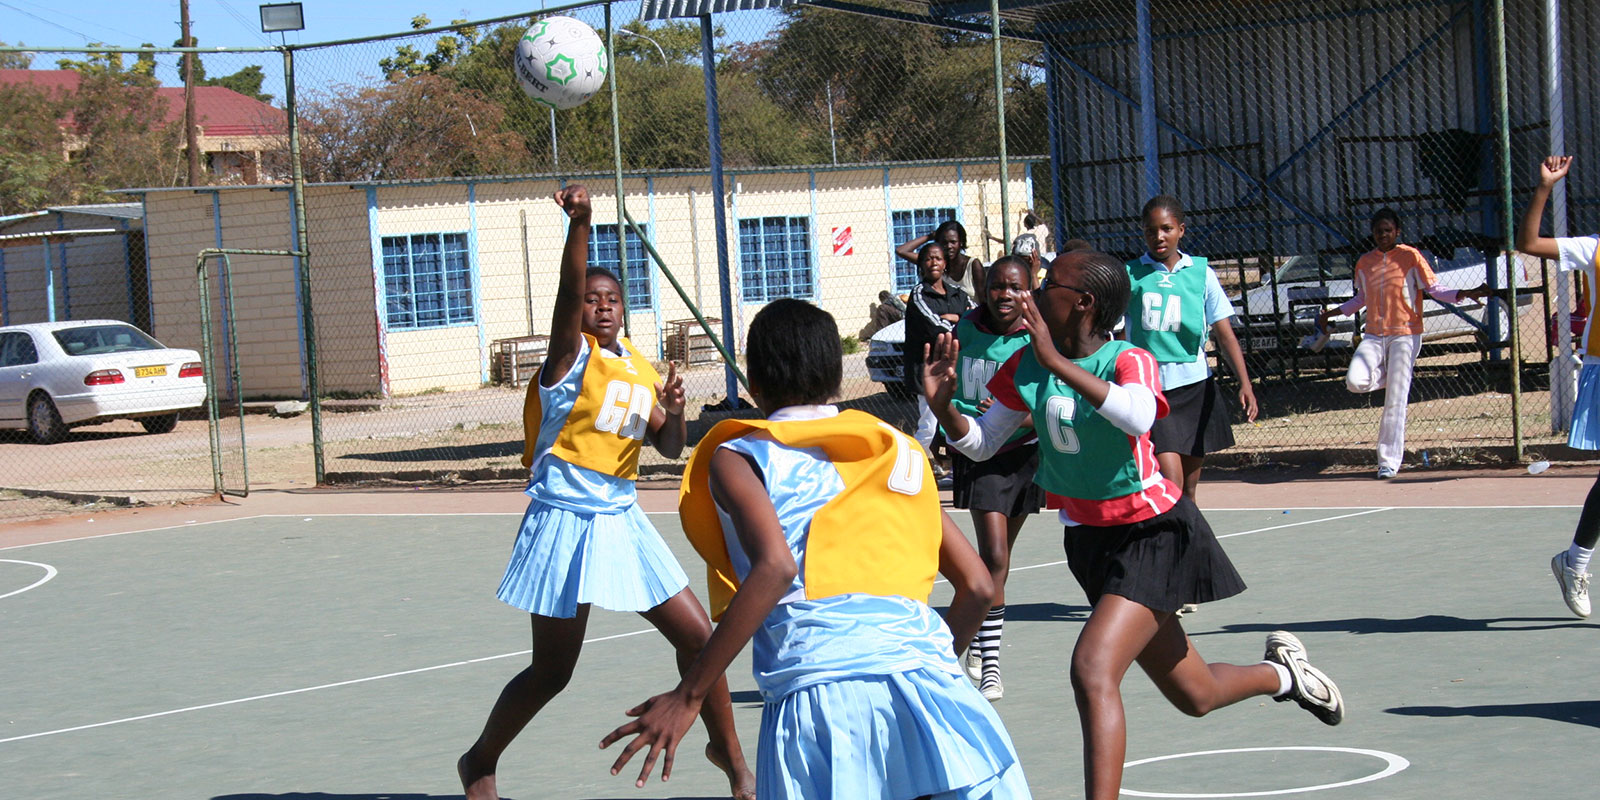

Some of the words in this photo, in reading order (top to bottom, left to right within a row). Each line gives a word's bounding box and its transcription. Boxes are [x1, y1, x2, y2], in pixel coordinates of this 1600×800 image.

[1142, 292, 1181, 332] GA
[962, 356, 1004, 400] W
[595, 379, 652, 440] GD
[1045, 395, 1080, 454] C
